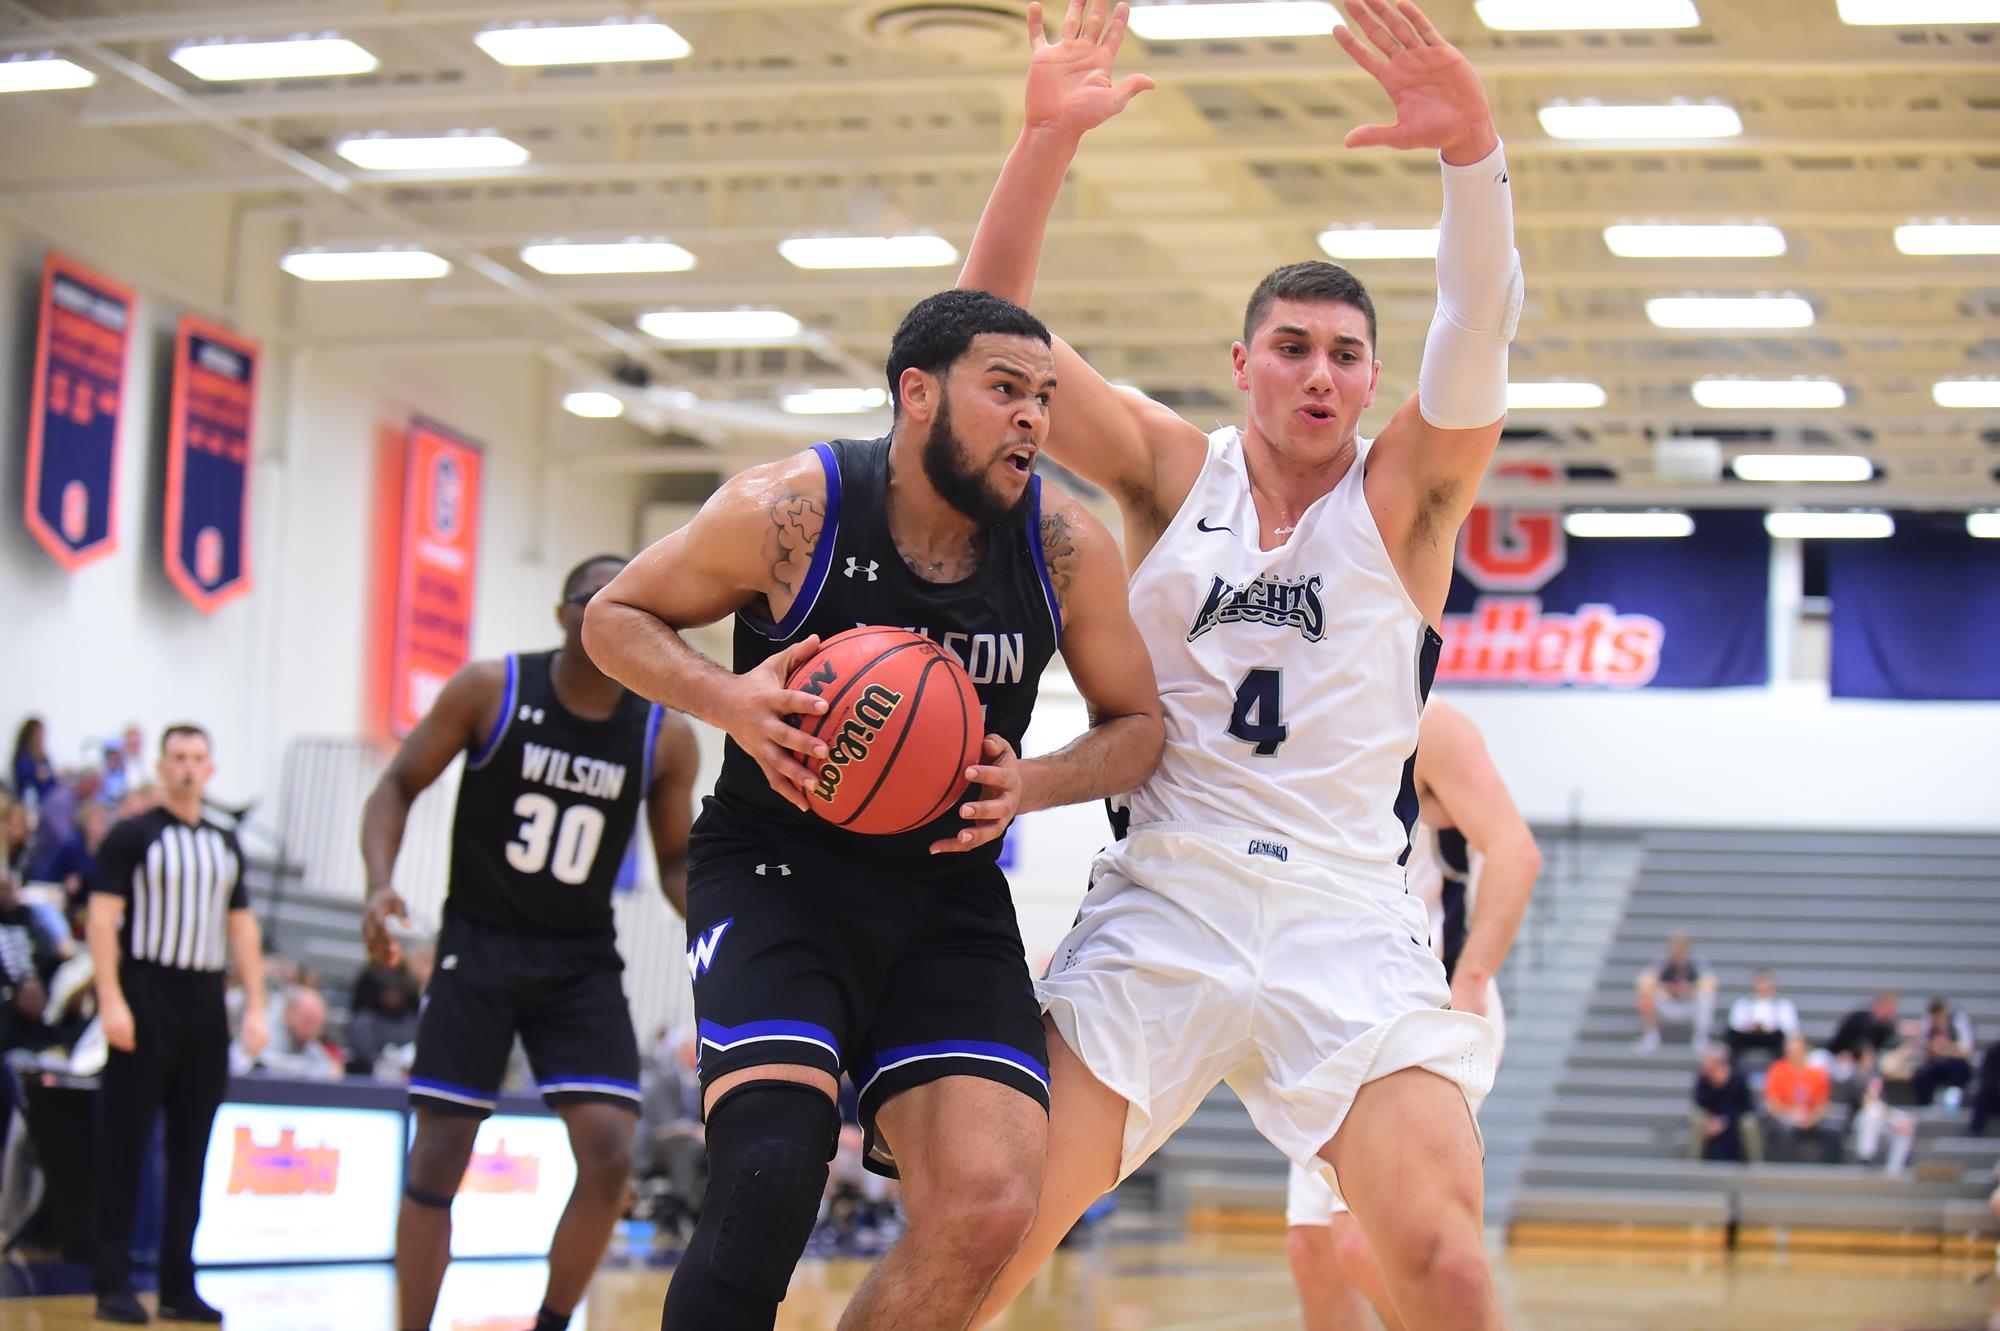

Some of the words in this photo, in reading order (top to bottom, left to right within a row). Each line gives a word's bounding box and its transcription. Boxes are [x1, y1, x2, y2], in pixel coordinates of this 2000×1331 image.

[1187, 573, 1325, 643] KNGHTS
[813, 683, 903, 803] Wilson
[1223, 667, 1290, 758] 4
[522, 742, 626, 800] WILSON
[505, 792, 605, 885] 30
[1248, 840, 1288, 862] GENESEO
[687, 917, 733, 984] W
